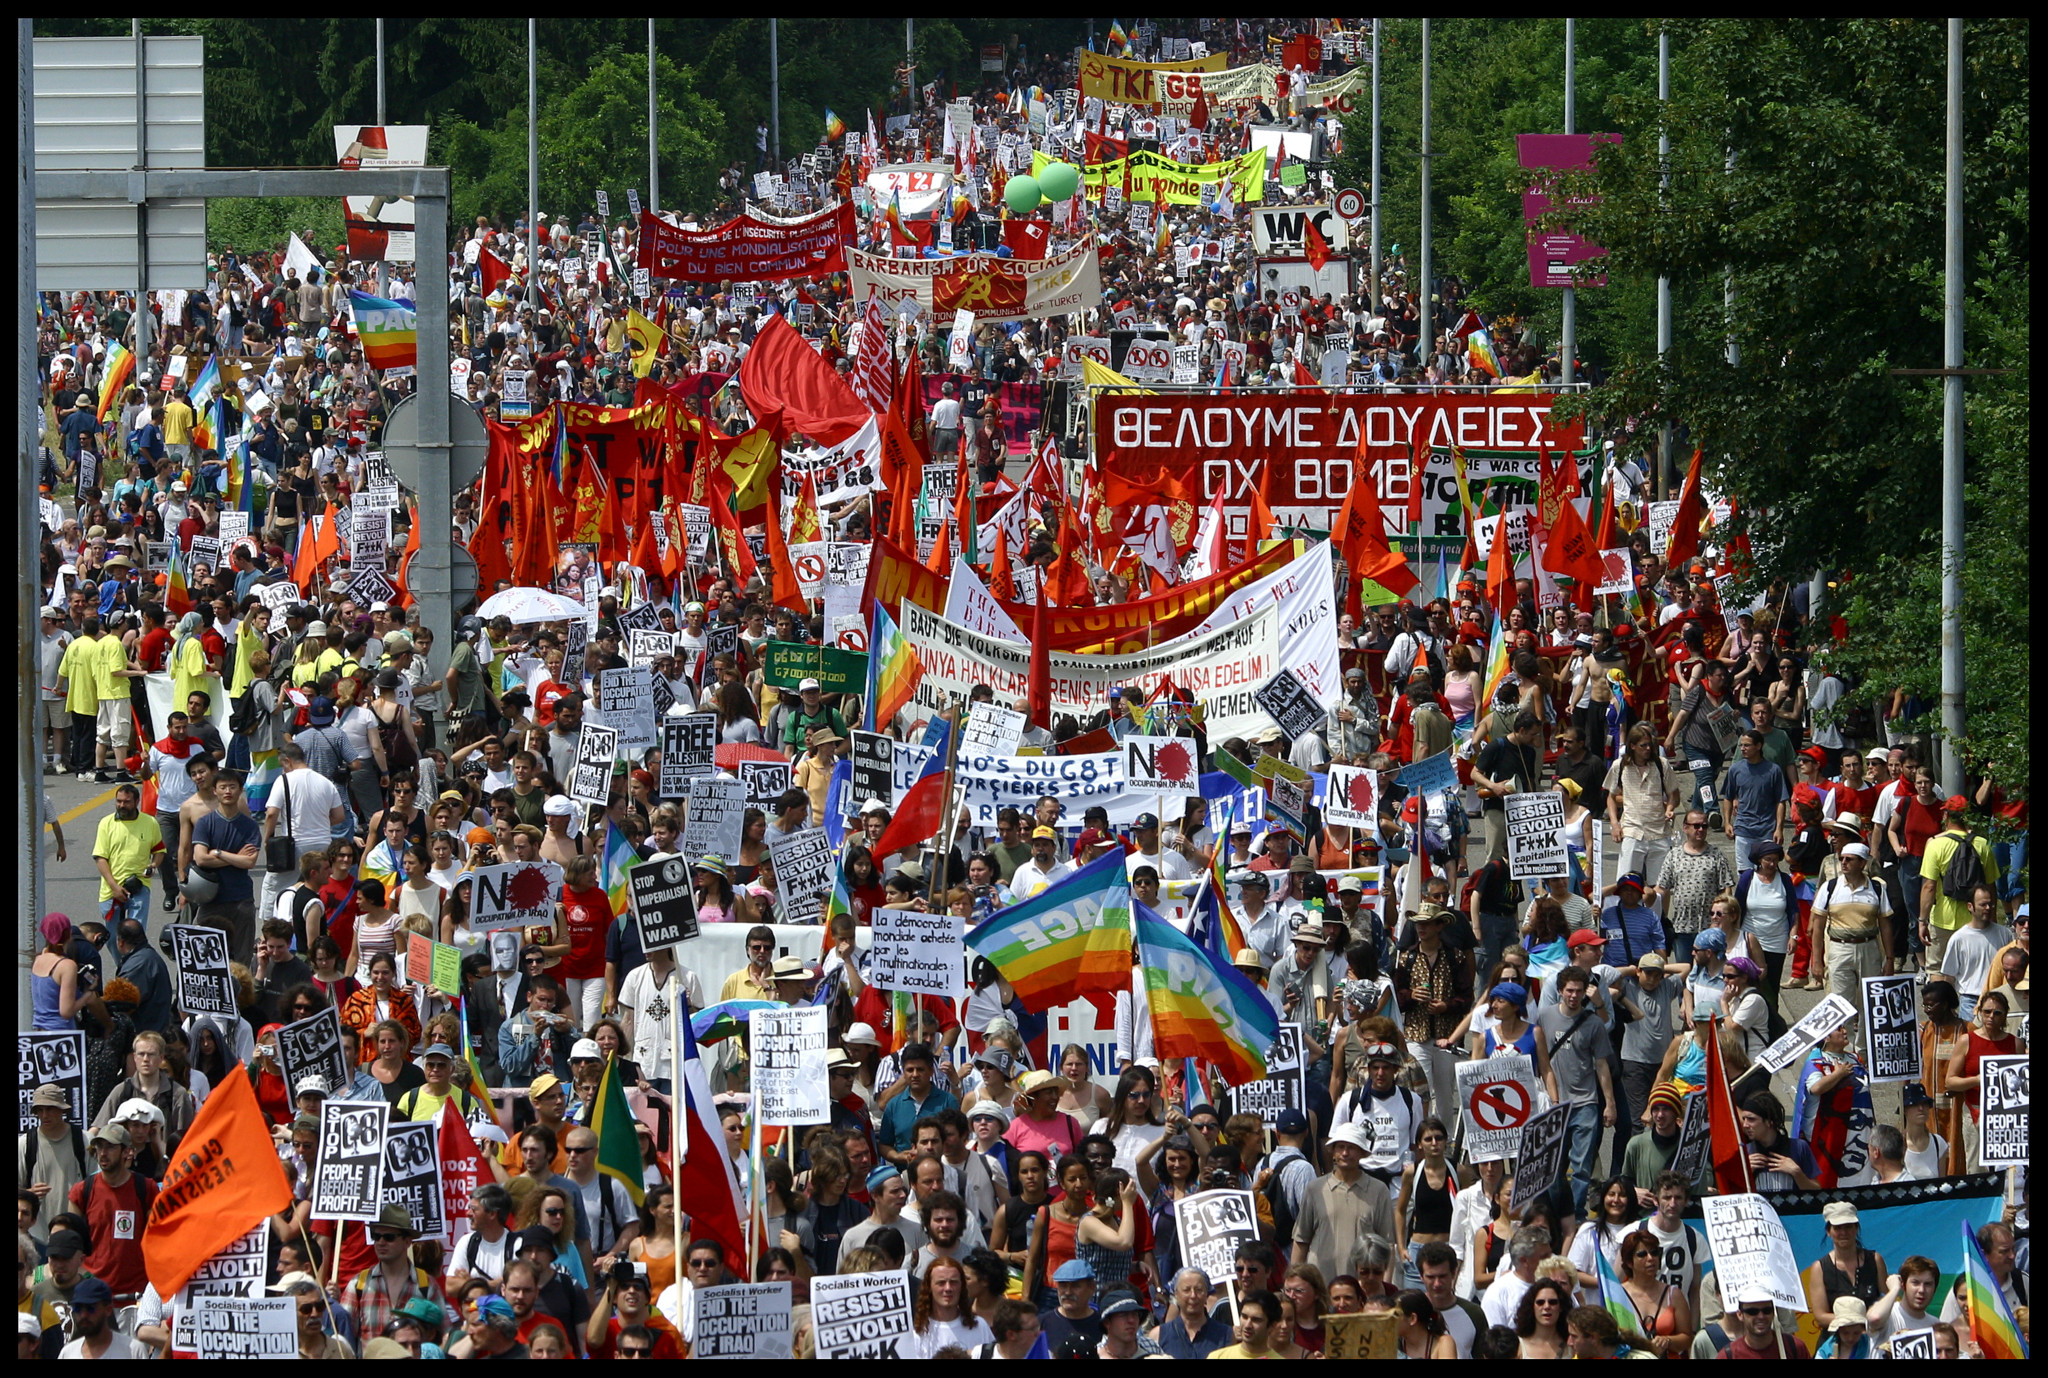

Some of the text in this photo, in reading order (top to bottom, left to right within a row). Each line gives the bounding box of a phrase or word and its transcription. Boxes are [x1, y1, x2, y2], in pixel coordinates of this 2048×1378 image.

[1167, 75, 1202, 99] G8
[1343, 198, 1357, 211] 60
[722, 230, 734, 242] DE
[1263, 210, 1334, 246] WC
[657, 239, 693, 258] POUR
[699, 246, 727, 260] UNE
[688, 261, 707, 275] DU
[749, 256, 807, 275] COMMUN
[853, 252, 954, 276] BARBARISM
[966, 256, 991, 274] OR
[733, 286, 753, 298] FREE
[1032, 291, 1085, 311] OF TURKEY
[366, 309, 416, 333] PAC
[1174, 350, 1198, 363] FREE
[1114, 405, 1556, 448] ΘΕΛΟΥΜΕ ΔΟΥΛΕΙΕΣ
[1490, 460, 1520, 473] WAR
[844, 464, 876, 488] G8
[1492, 479, 1537, 505] THE
[910, 610, 963, 647] BAUT DIE
[1205, 630, 1233, 655] WELT
[603, 676, 636, 687] END THE
[603, 684, 651, 699] OCCUPATION
[604, 697, 636, 711] OF IRAQ
[974, 709, 1006, 727] END THE
[1001, 710, 1022, 721] Worker
[664, 722, 714, 752] FREE
[967, 729, 999, 748] OF IRAQ
[970, 721, 1020, 741] OCCUPATION
[581, 726, 593, 761] STOP
[856, 740, 871, 753] STOP
[663, 751, 714, 766] PALESTINE
[855, 756, 891, 773] IMPERIALISM
[578, 764, 602, 778] PEOPLE
[855, 772, 869, 785] NO
[1059, 759, 1099, 783] G8
[693, 786, 728, 798] END THE
[1129, 779, 1169, 789] OCCUPATION
[692, 798, 744, 812] OCCUPATION
[1508, 801, 1561, 822] RESIST!
[690, 811, 723, 823] OF IRAQ
[1509, 816, 1562, 836] REVOLT!
[685, 841, 708, 852] Fight
[774, 836, 829, 866] RESIST!
[1514, 848, 1565, 864] capitalism
[777, 851, 832, 881] REVOLT!
[634, 874, 656, 891] STOP
[638, 884, 690, 908] IMPERIALISM
[475, 908, 549, 925] OCCUPATION OF IRAQ
[642, 911, 663, 927] NO
[894, 912, 952, 930] démocratie
[646, 924, 680, 944] WAR
[873, 929, 956, 944] mondiale achetée
[896, 943, 909, 956] les
[880, 955, 948, 971] multinationales
[183, 972, 219, 988] PEOPLE
[875, 969, 896, 989] quel
[184, 983, 220, 999] BEFORE
[185, 996, 221, 1012] PROFIT
[758, 1009, 820, 1019] Socialist Worker
[755, 1019, 802, 1035] END THE
[754, 1032, 825, 1052] OCCUPATION
[1874, 1032, 1909, 1048] PEOPLE
[754, 1051, 801, 1069] OF IRAQ
[1876, 1058, 1910, 1076] PROFIT
[766, 1069, 795, 1078] and US
[780, 1086, 799, 1095] East
[1239, 1079, 1286, 1094] PEOPLE
[1986, 1060, 2000, 1111] STOP
[1239, 1093, 1286, 1108] BEFORE
[1375, 1117, 1394, 1125] STOP
[1986, 1113, 2029, 1130] PEOPLE
[323, 1106, 342, 1160] STOP
[1986, 1128, 2029, 1144] BEFORE
[1986, 1142, 2029, 1159] PROFIT
[322, 1163, 363, 1181] PEOPLE
[320, 1180, 362, 1196] BEFORE
[317, 1195, 361, 1213] PROFIT
[1712, 1197, 1751, 1208] Socialist
[1709, 1204, 1764, 1221] END THE
[1712, 1219, 1788, 1242] OCCUPATION
[1189, 1236, 1240, 1261] PEOPLE
[1715, 1235, 1769, 1257] OF IRAQ
[703, 1285, 784, 1299] Socialist Worker
[814, 1275, 903, 1292] Socialist Worker
[205, 1299, 286, 1311] Socialist Worker
[698, 1296, 758, 1318] END THE
[816, 1286, 906, 1325] RESIST!
[201, 1310, 259, 1333] END THE
[698, 1314, 790, 1337] OCCUPATION
[818, 1312, 909, 1350] REVOLT!
[202, 1330, 294, 1354] OCCUPATION
[698, 1333, 756, 1357] OF IRAQ
